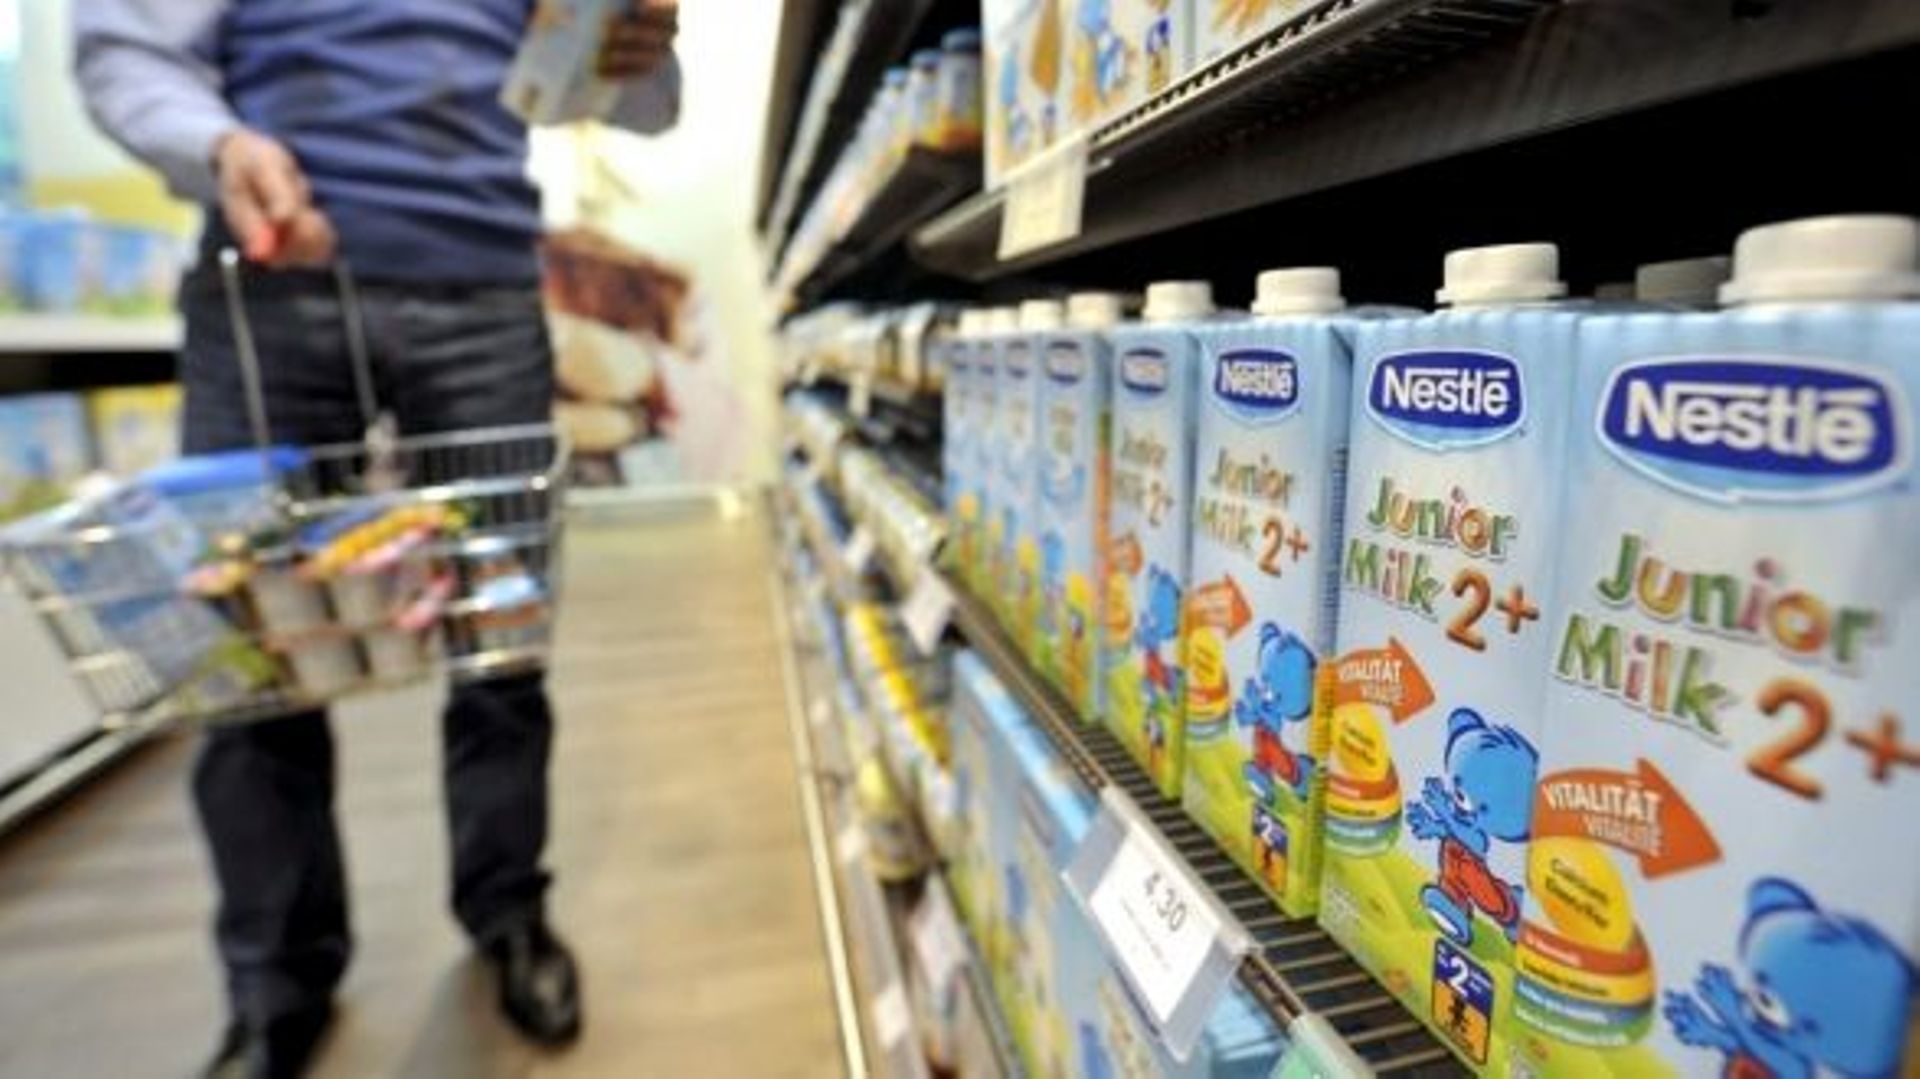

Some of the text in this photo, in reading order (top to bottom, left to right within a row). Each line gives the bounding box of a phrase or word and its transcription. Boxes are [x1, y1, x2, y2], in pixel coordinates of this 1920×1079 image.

[1382, 365, 1510, 417] Nestlé
[1624, 379, 1879, 463] Nestlé
[1209, 448, 1294, 506] Junior
[1258, 516, 1309, 578] 2+
[1367, 475, 1519, 561] Junior
[1343, 537, 1540, 651] Milk 2+
[1597, 533, 1881, 668] Junior
[1552, 612, 1920, 802] Milk 2+
[1541, 779, 1662, 823] VITALITÄT
[1448, 956, 1469, 998] 2
